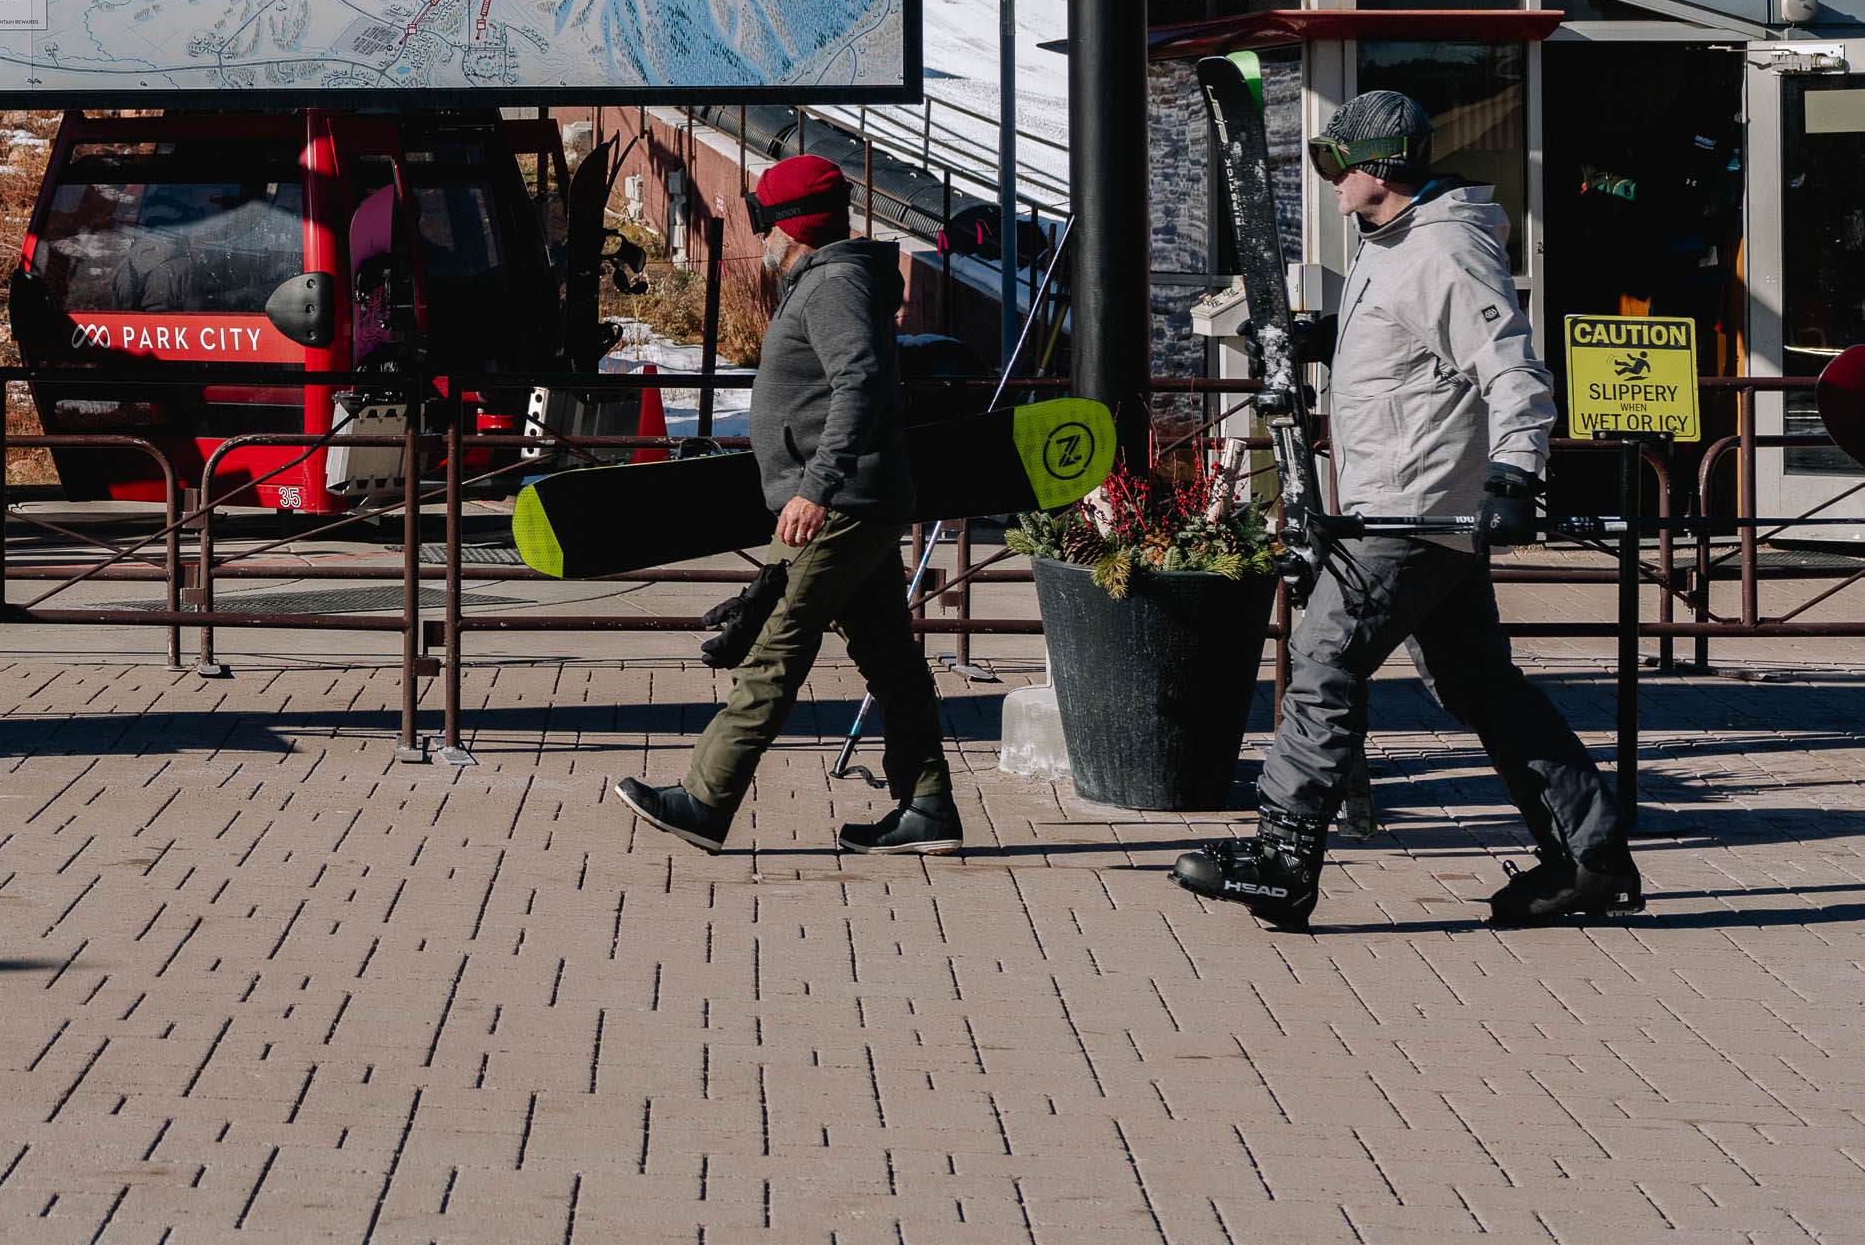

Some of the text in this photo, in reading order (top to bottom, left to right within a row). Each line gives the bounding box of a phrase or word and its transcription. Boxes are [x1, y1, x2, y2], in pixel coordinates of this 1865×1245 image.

[122, 326, 262, 351] PARK CITY
[1574, 323, 1687, 346] CAUTION
[1589, 383, 1678, 402] SLIPPERY
[1620, 403, 1647, 412] WHEN
[1581, 413, 1689, 432] WET OR ICY
[278, 487, 302, 508] 35
[1224, 880, 1288, 898] HEAD
